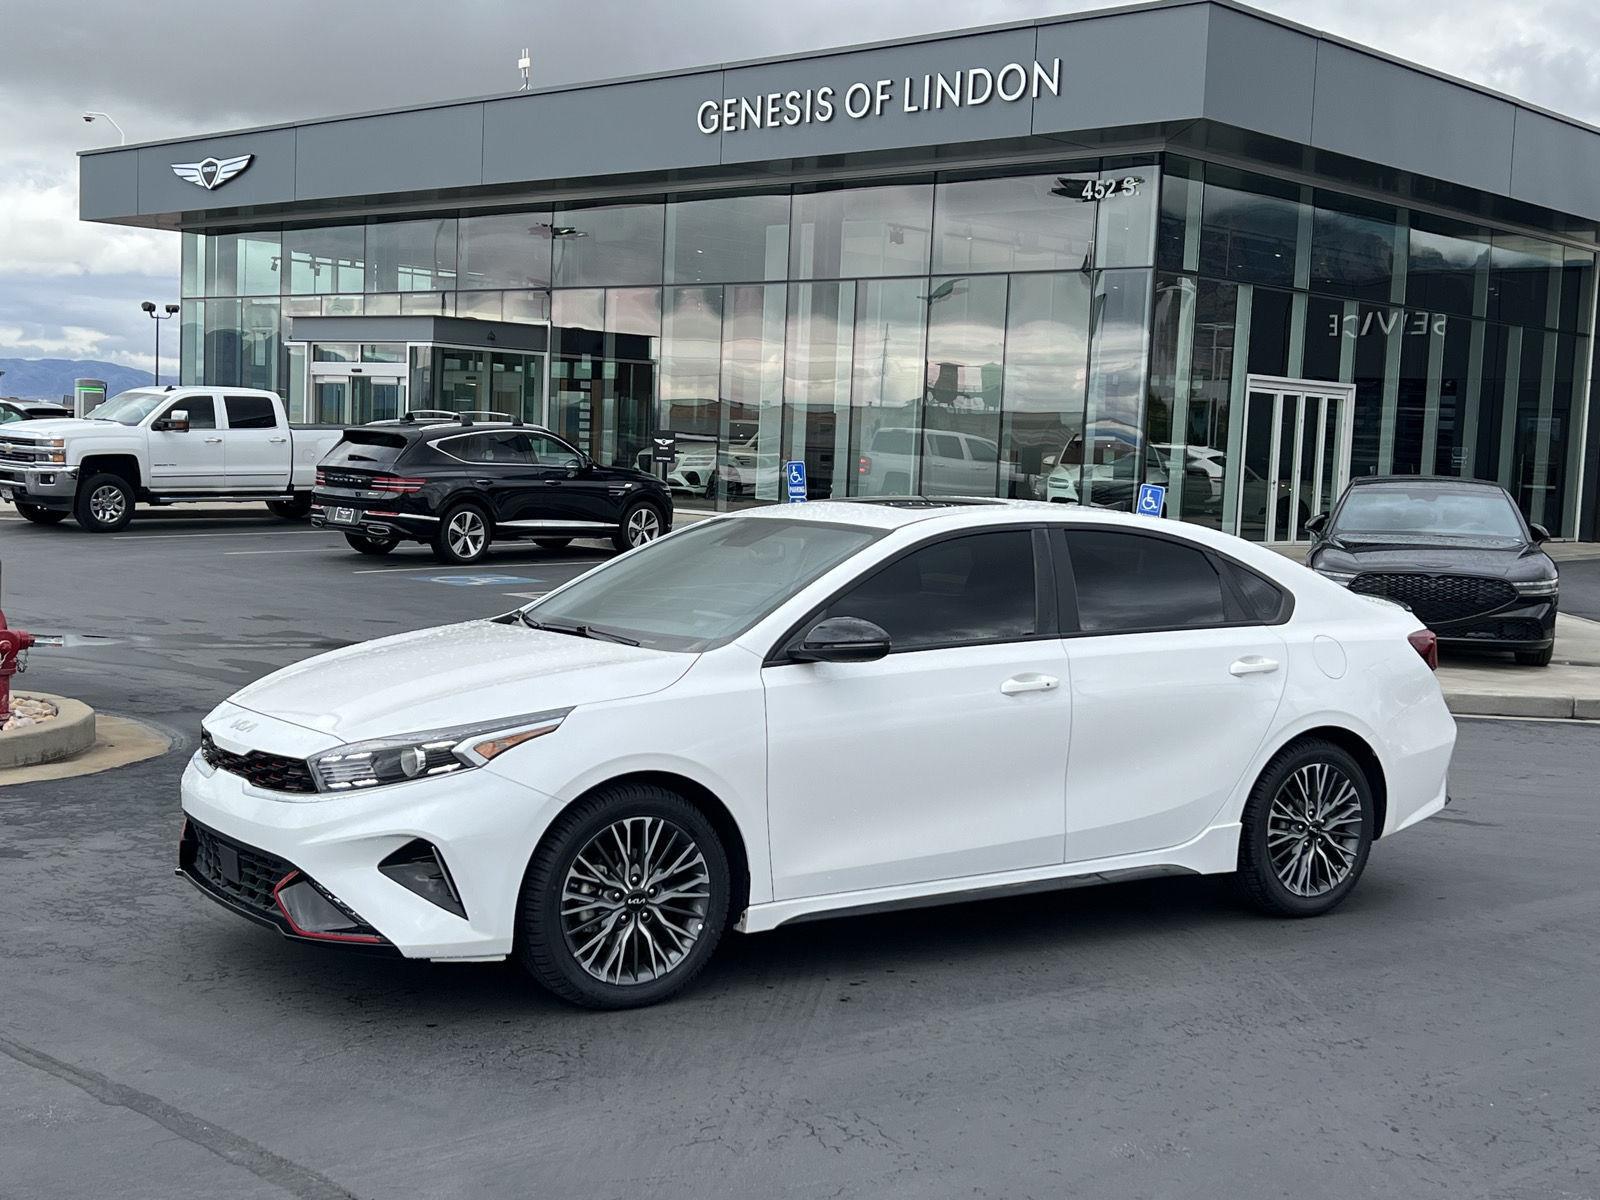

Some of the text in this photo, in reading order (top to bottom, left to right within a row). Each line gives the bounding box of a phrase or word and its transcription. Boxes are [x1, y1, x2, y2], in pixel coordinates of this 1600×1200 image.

[697, 57, 1062, 134] GENESIS OF LINDON
[1081, 179, 1116, 200] 452
